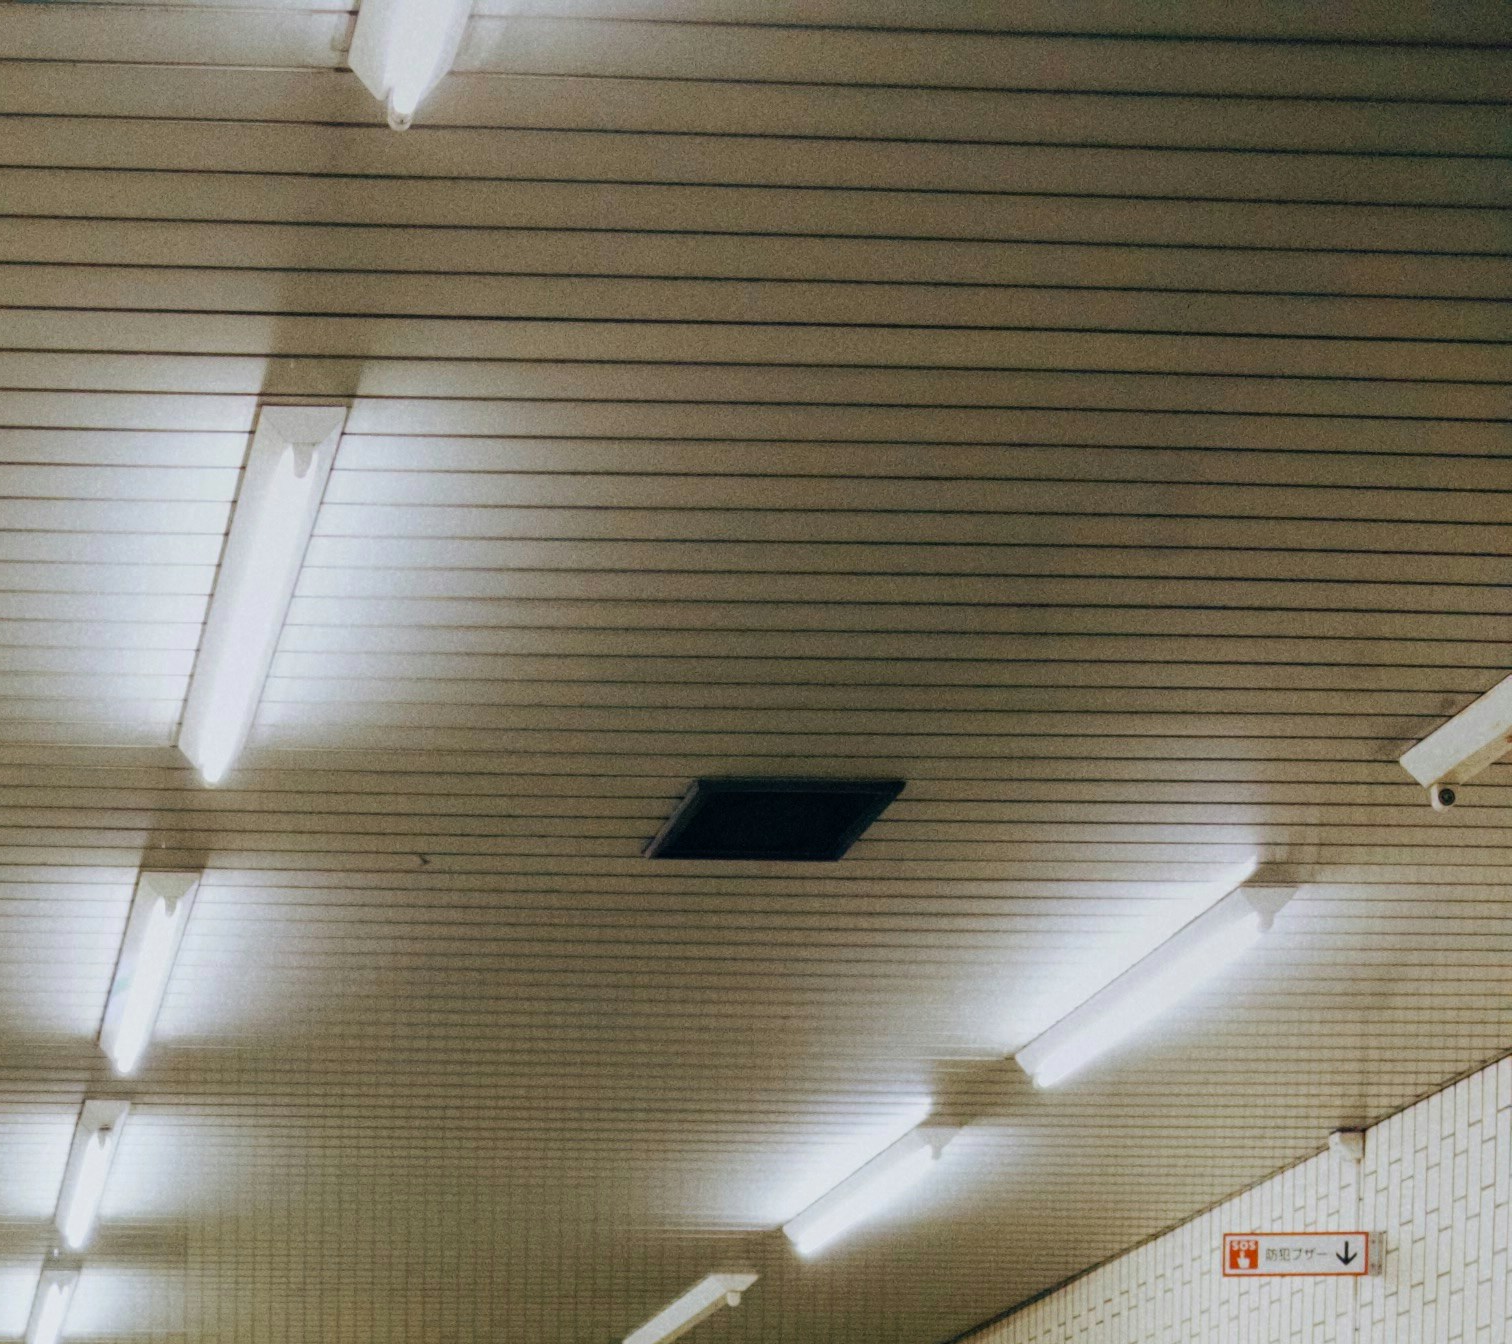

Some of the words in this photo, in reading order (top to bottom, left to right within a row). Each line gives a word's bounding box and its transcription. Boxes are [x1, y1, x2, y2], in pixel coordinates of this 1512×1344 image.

[1231, 1241, 1257, 1251] SOS
[1265, 1248, 1328, 1262] 防犯ブザー
